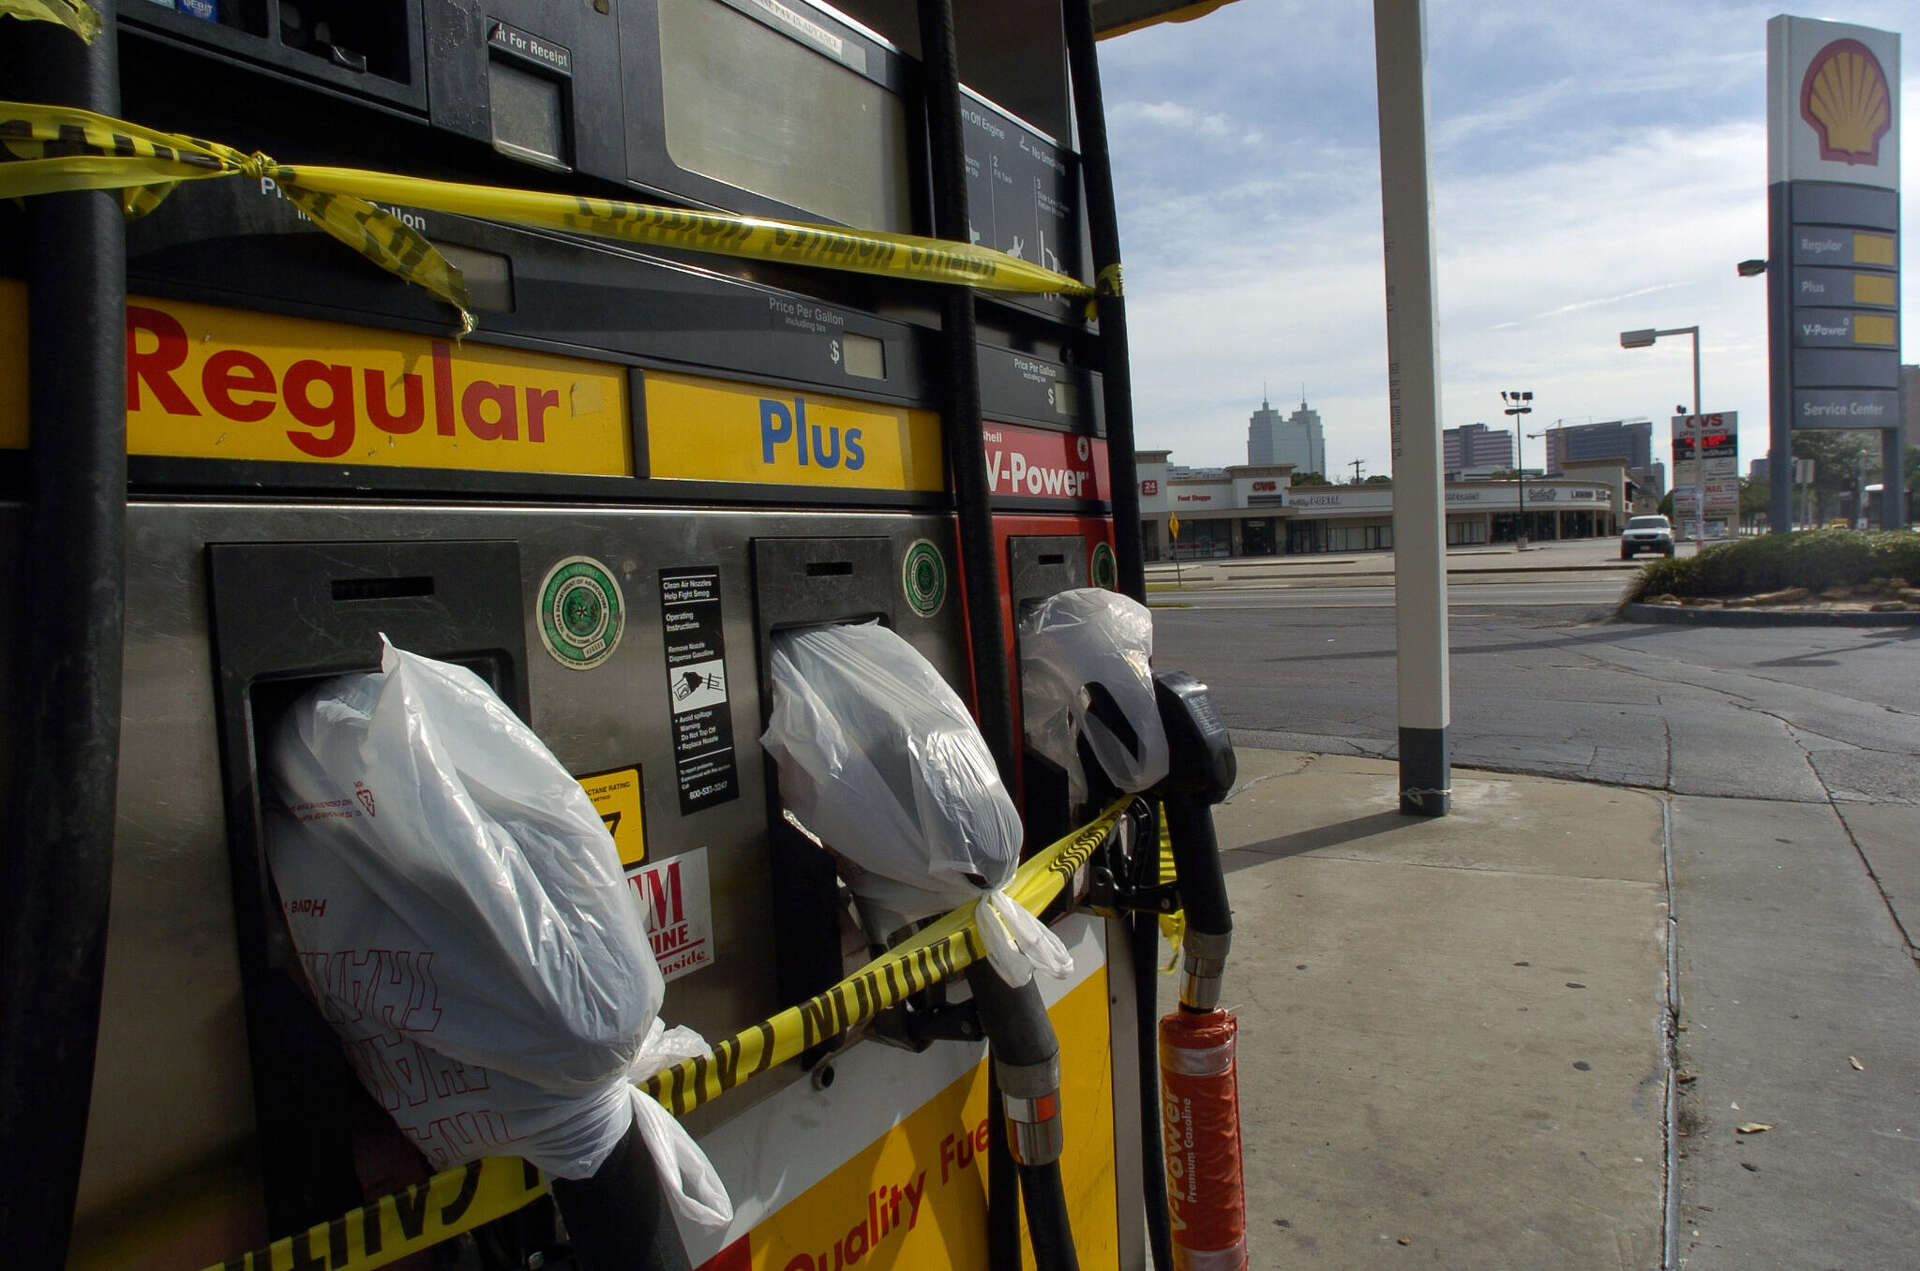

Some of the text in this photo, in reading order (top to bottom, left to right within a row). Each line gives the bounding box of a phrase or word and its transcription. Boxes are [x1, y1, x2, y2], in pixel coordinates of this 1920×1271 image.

[509, 32, 527, 50] For
[530, 40, 568, 67] Receipt
[982, 118, 1005, 139] Engine
[1802, 238, 1842, 253] Regular
[1802, 280, 1825, 293] Plus
[768, 297, 844, 326] Price Per Gallon
[1803, 323, 1847, 336] V-Power
[830, 339, 840, 364] $
[1014, 358, 1056, 377] Price Per Gallon
[127, 305, 559, 458] Regular
[1803, 402, 1884, 417] Service Center
[760, 399, 865, 471] Plus
[984, 450, 1085, 497] V-Power
[1252, 481, 1276, 492] CVS
[690, 580, 712, 588] Nozzles
[664, 592, 677, 601] Help
[678, 591, 692, 600] Fight
[665, 611, 694, 622] Operating
[608, 781, 631, 792] RATING
[291, 898, 326, 917] Have
[648, 923, 689, 954] INE
[939, 1117, 989, 1187] Fue
[1181, 1097, 1197, 1204] Premium Gasoline
[1165, 1091, 1187, 1231] V-Power
